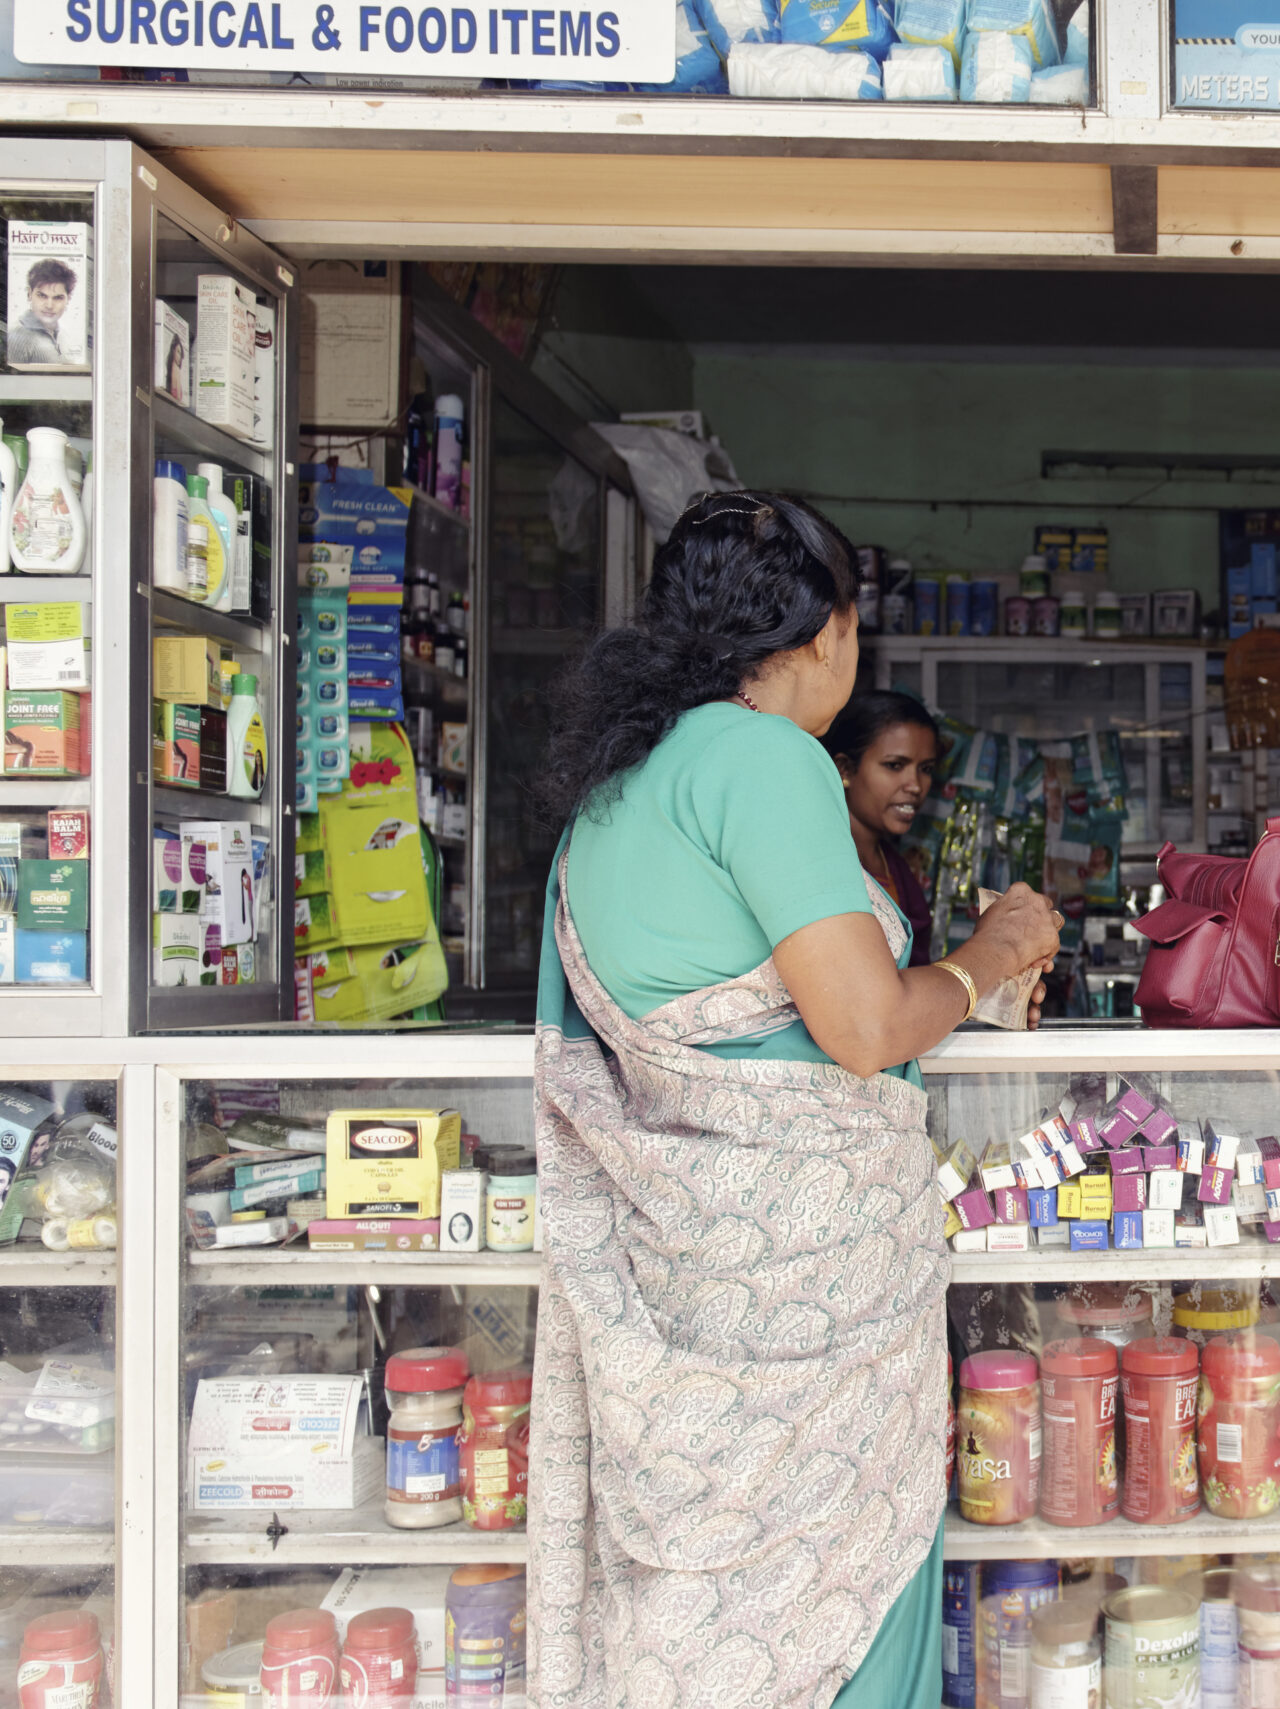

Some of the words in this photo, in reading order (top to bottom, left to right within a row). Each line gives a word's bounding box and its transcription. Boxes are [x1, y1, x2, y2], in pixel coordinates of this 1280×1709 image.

[65, 0, 294, 50] SURGICAL
[312, 4, 341, 51] &
[359, 6, 477, 54] FOOD
[489, 9, 621, 57] ITEMS
[336, 77, 348, 86] Low
[1181, 75, 1269, 103] METERS
[332, 499, 362, 509] FRESH
[365, 501, 396, 512] CLEAN
[7, 704, 33, 713] JOINT
[37, 704, 59, 713] FREE
[2, 1135, 15, 1145] 50
[361, 1134, 406, 1144] SEACOD
[366, 1204, 392, 1212] SANOFI
[1073, 1230, 1102, 1238] ODOMOS
[299, 1419, 338, 1429] ZEECOLD
[201, 1487, 242, 1497] ZEECOLD
[420, 1493, 433, 1501] 200
[1169, 1668, 1179, 1680] 2
[417, 1700, 446, 1709] Acilo
